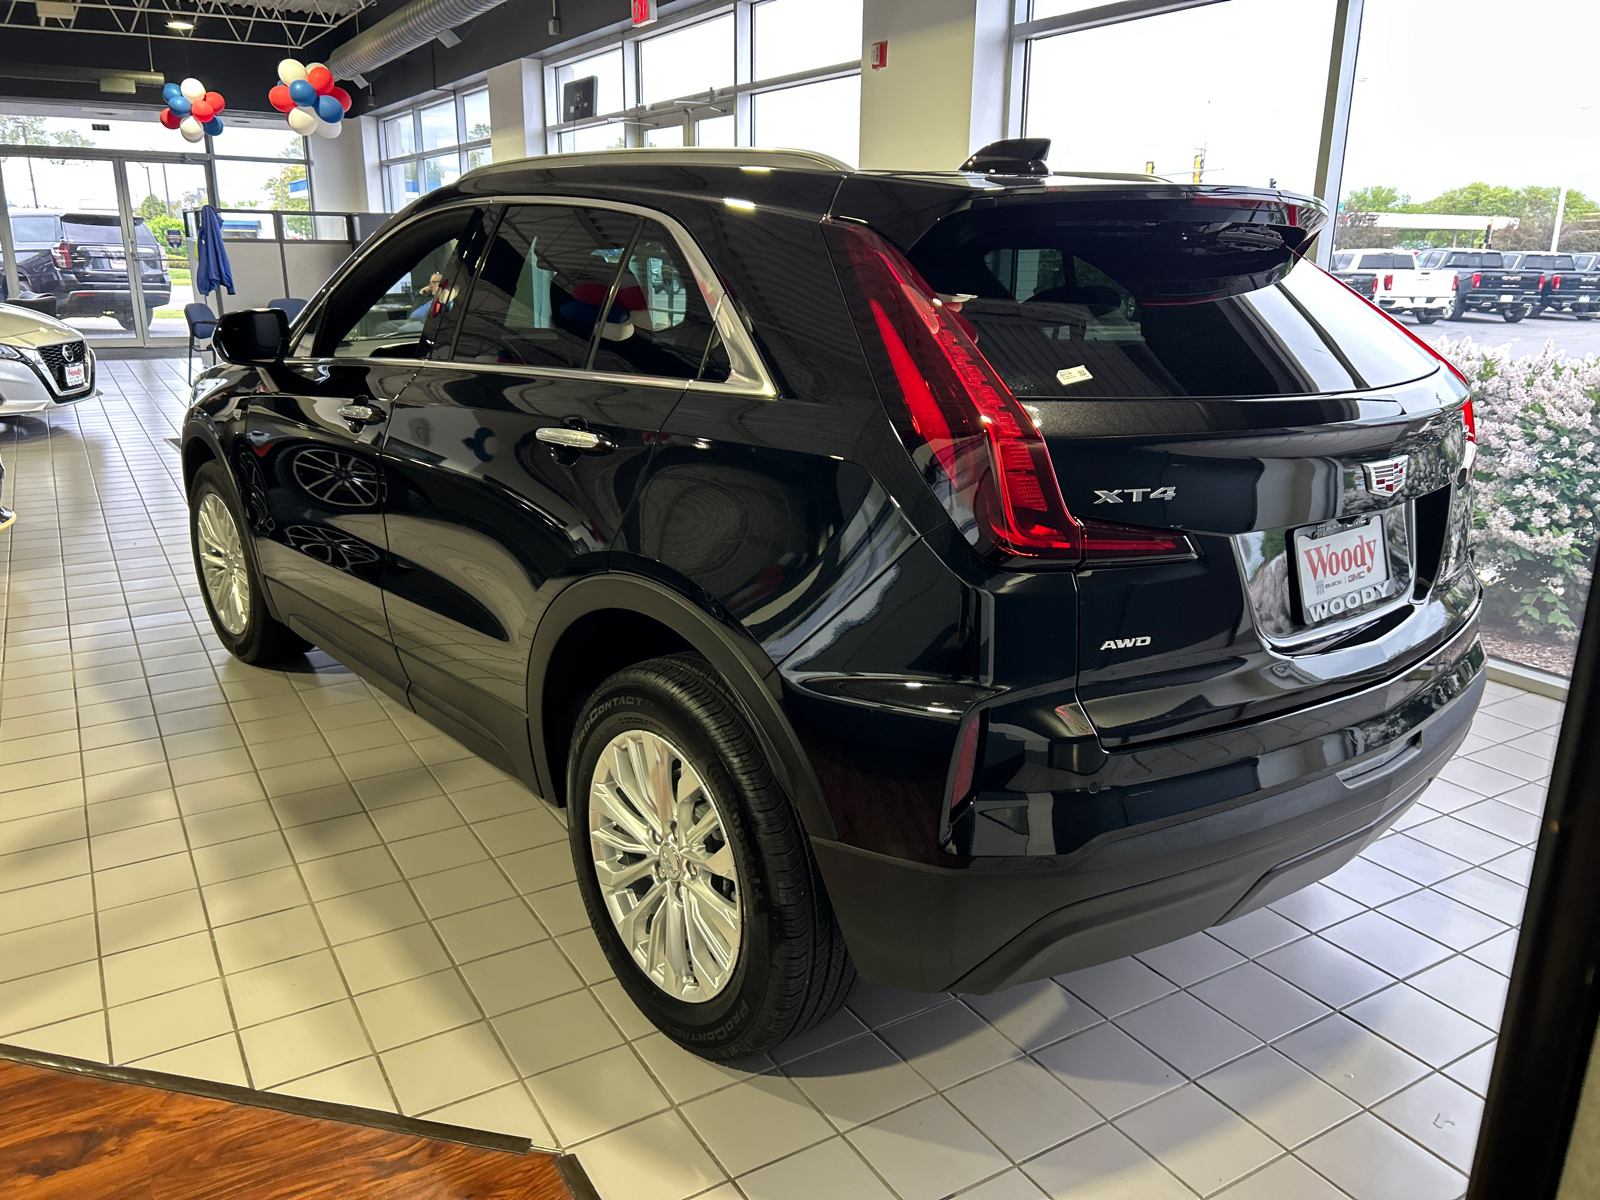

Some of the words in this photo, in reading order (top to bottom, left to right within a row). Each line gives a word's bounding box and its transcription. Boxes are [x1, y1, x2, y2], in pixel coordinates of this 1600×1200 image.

[1093, 486, 1177, 505] XT4
[1303, 534, 1378, 582] Woody
[1325, 578, 1343, 589] BUICK
[1348, 571, 1366, 583] GMC
[1308, 579, 1391, 623] WOODY
[1100, 636, 1152, 651] AWD
